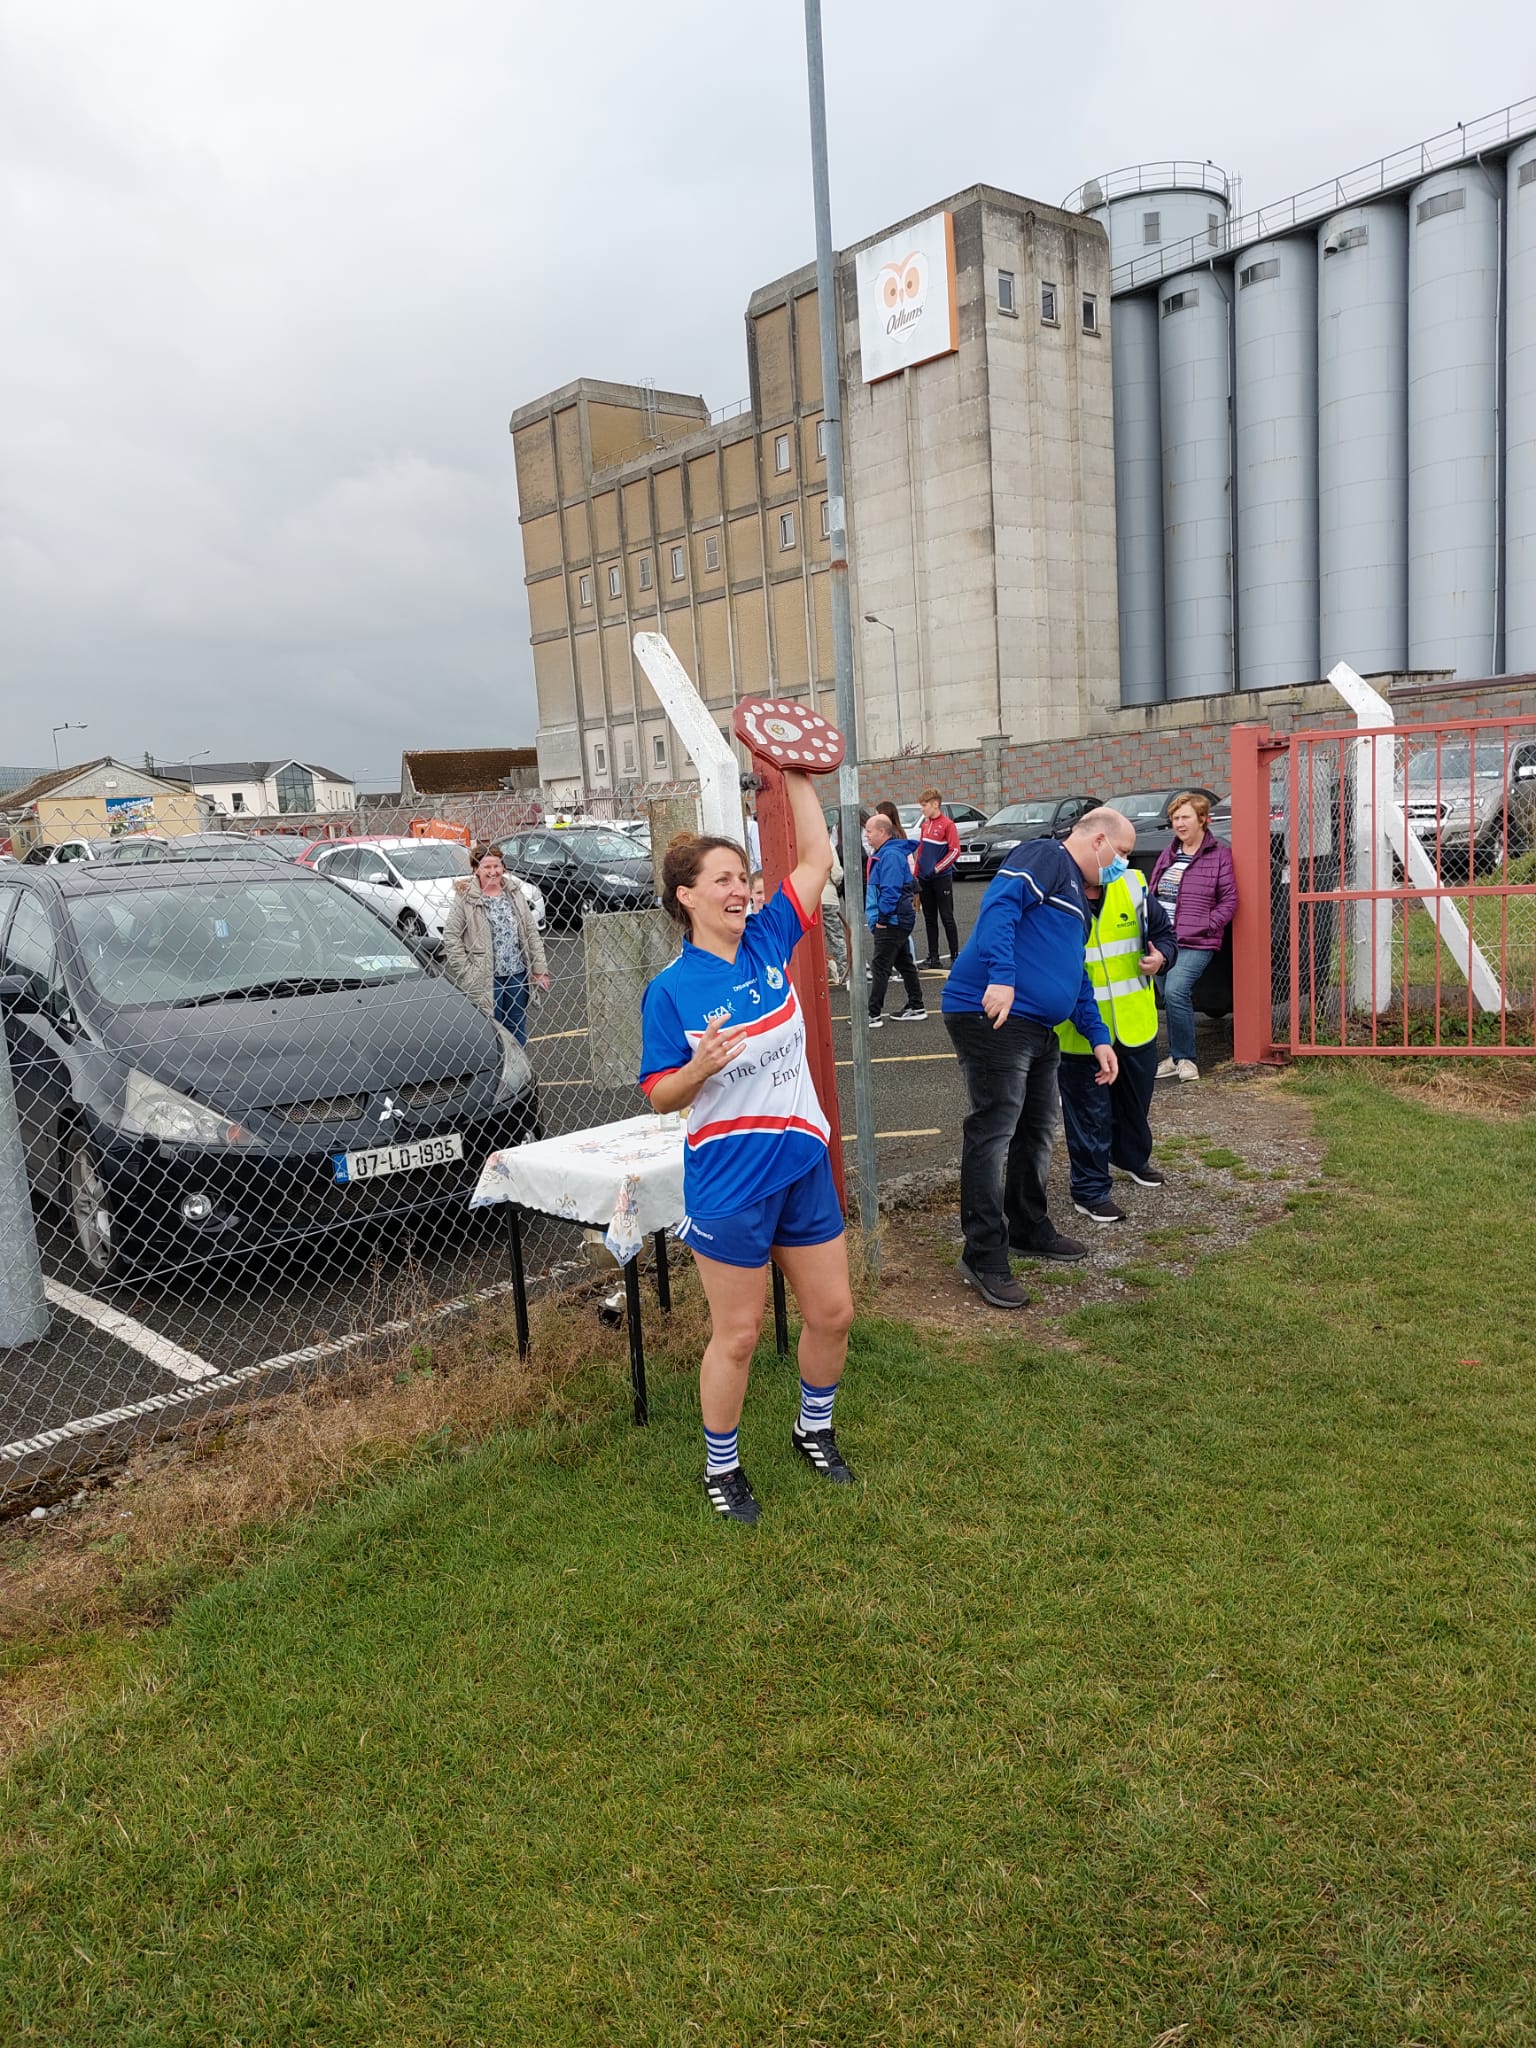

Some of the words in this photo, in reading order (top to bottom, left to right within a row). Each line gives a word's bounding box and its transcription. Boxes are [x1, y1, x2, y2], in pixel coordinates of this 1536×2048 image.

[886, 304, 923, 335] Odlums
[107, 804, 121, 812] Code
[749, 988, 760, 1004] 3
[723, 1064, 757, 1083] The
[760, 1043, 791, 1067] Gate
[355, 1139, 454, 1176] 07-LD-1935
